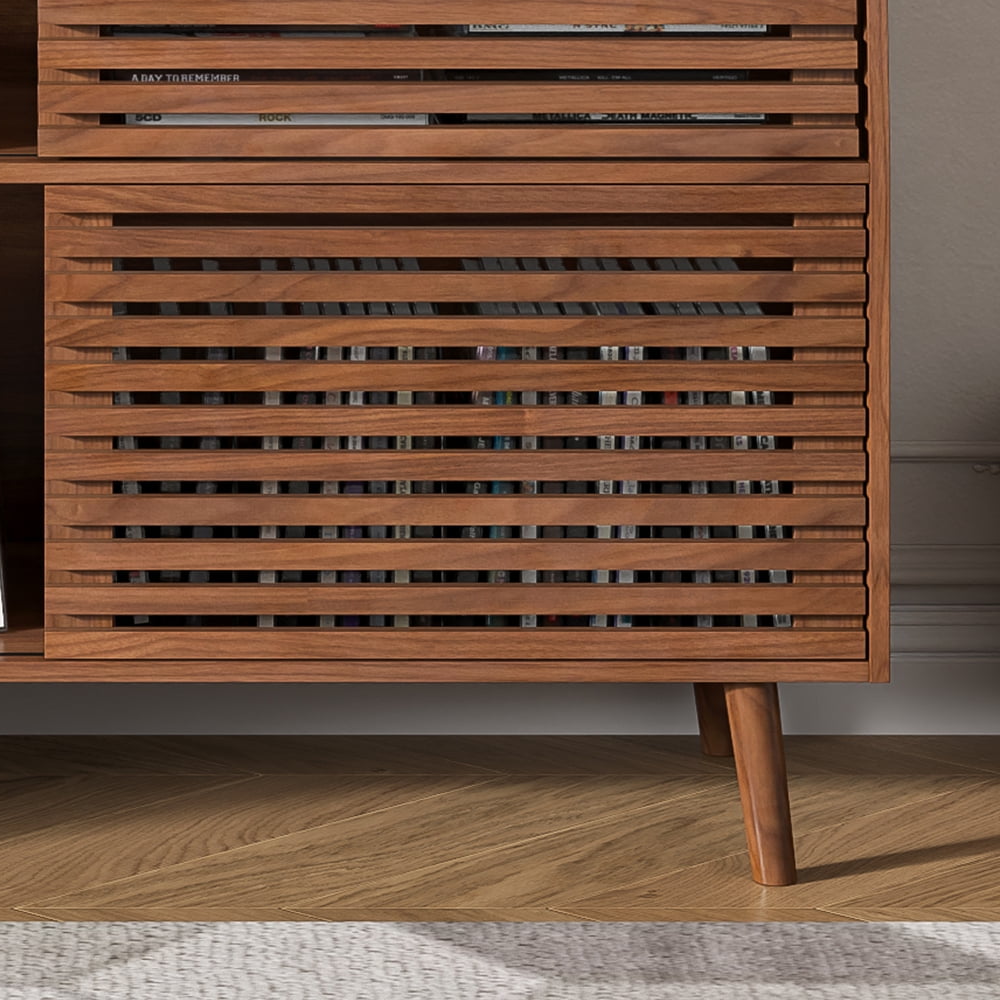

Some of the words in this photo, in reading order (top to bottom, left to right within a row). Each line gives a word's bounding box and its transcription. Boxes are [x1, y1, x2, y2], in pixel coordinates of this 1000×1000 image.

[131, 74, 139, 82] A
[135, 114, 162, 122] 5CD
[258, 114, 292, 122] ROCK
